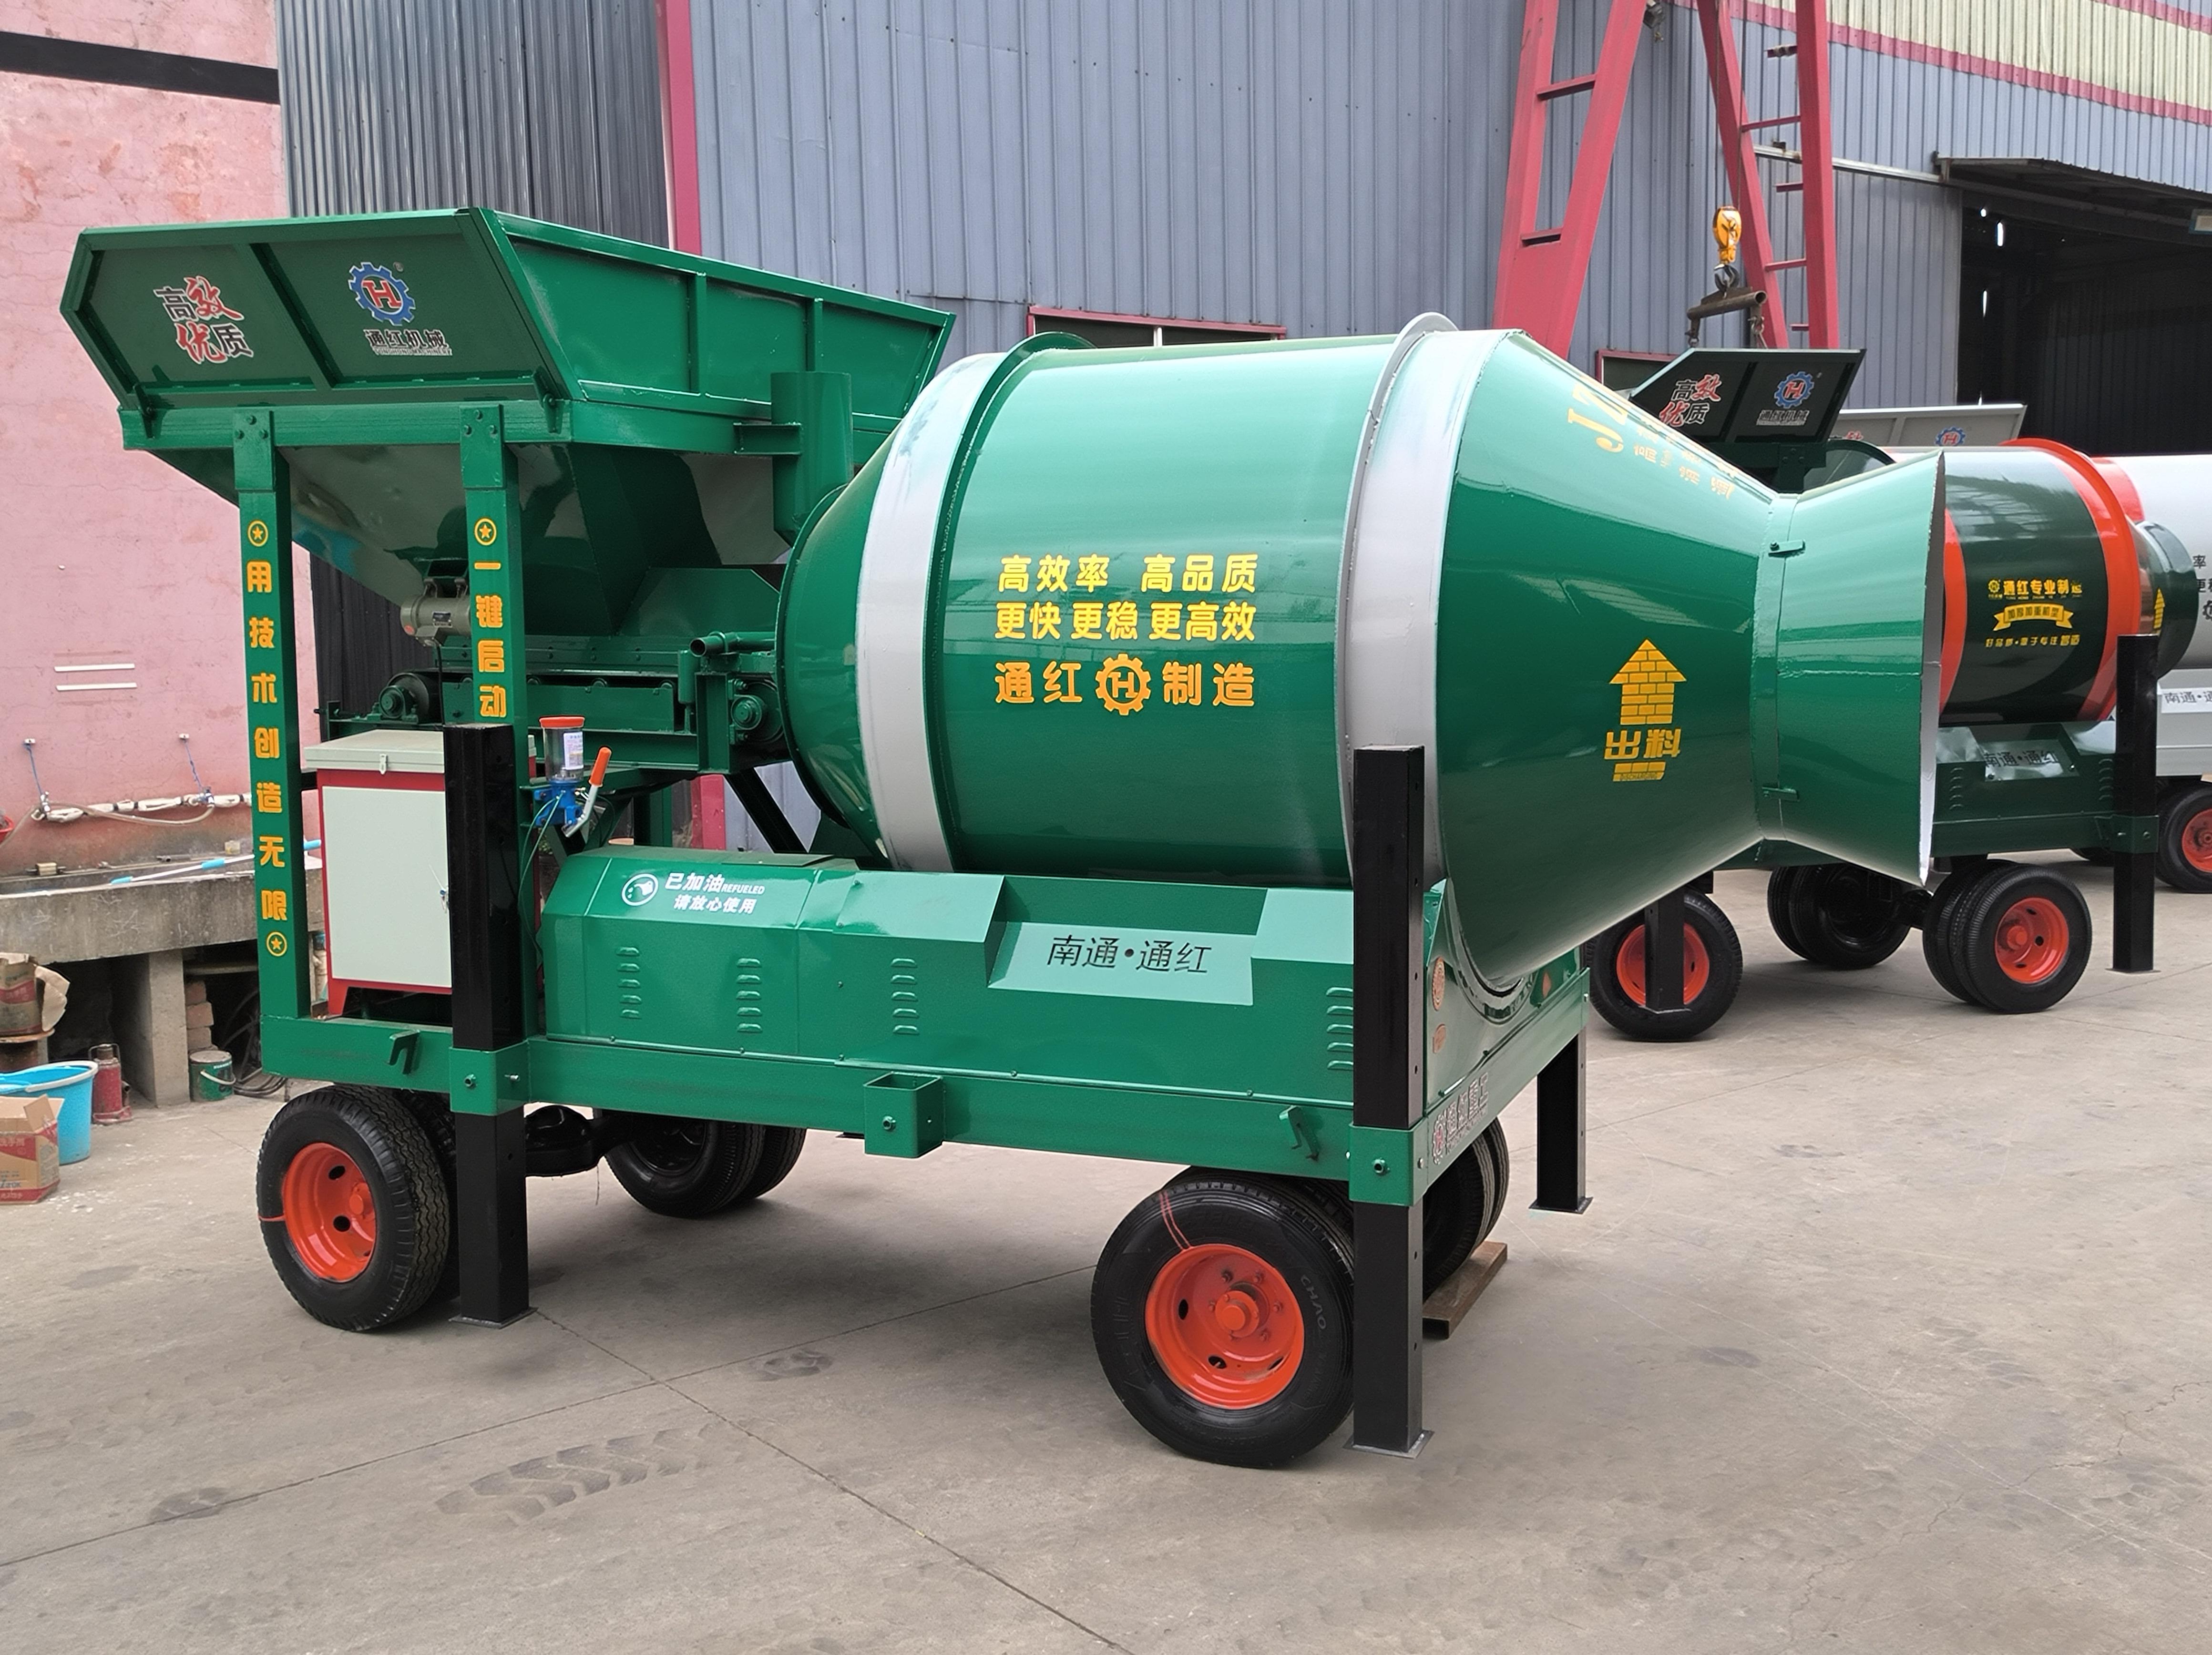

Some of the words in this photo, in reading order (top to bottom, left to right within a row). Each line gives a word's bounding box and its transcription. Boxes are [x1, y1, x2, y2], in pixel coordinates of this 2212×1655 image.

[153, 276, 244, 321] 高效
[174, 321, 254, 364] 优质
[363, 329, 449, 348] 通红机械
[1671, 374, 1722, 402] 高效
[1659, 401, 1710, 427] 优质
[998, 554, 1110, 593] 高效率
[1141, 553, 1259, 593] 高品质
[2003, 578, 2082, 595] 通红专业制造
[474, 562, 507, 718] 一键启动
[995, 661, 1083, 704] 通红
[1162, 661, 1255, 707] 制造
[246, 560, 287, 920] 用技术创造无限
[1604, 728, 1681, 759] 出料
[665, 872, 725, 892] 已加油
[721, 883, 766, 895] REFUELED
[673, 894, 758, 915] 请放心使用
